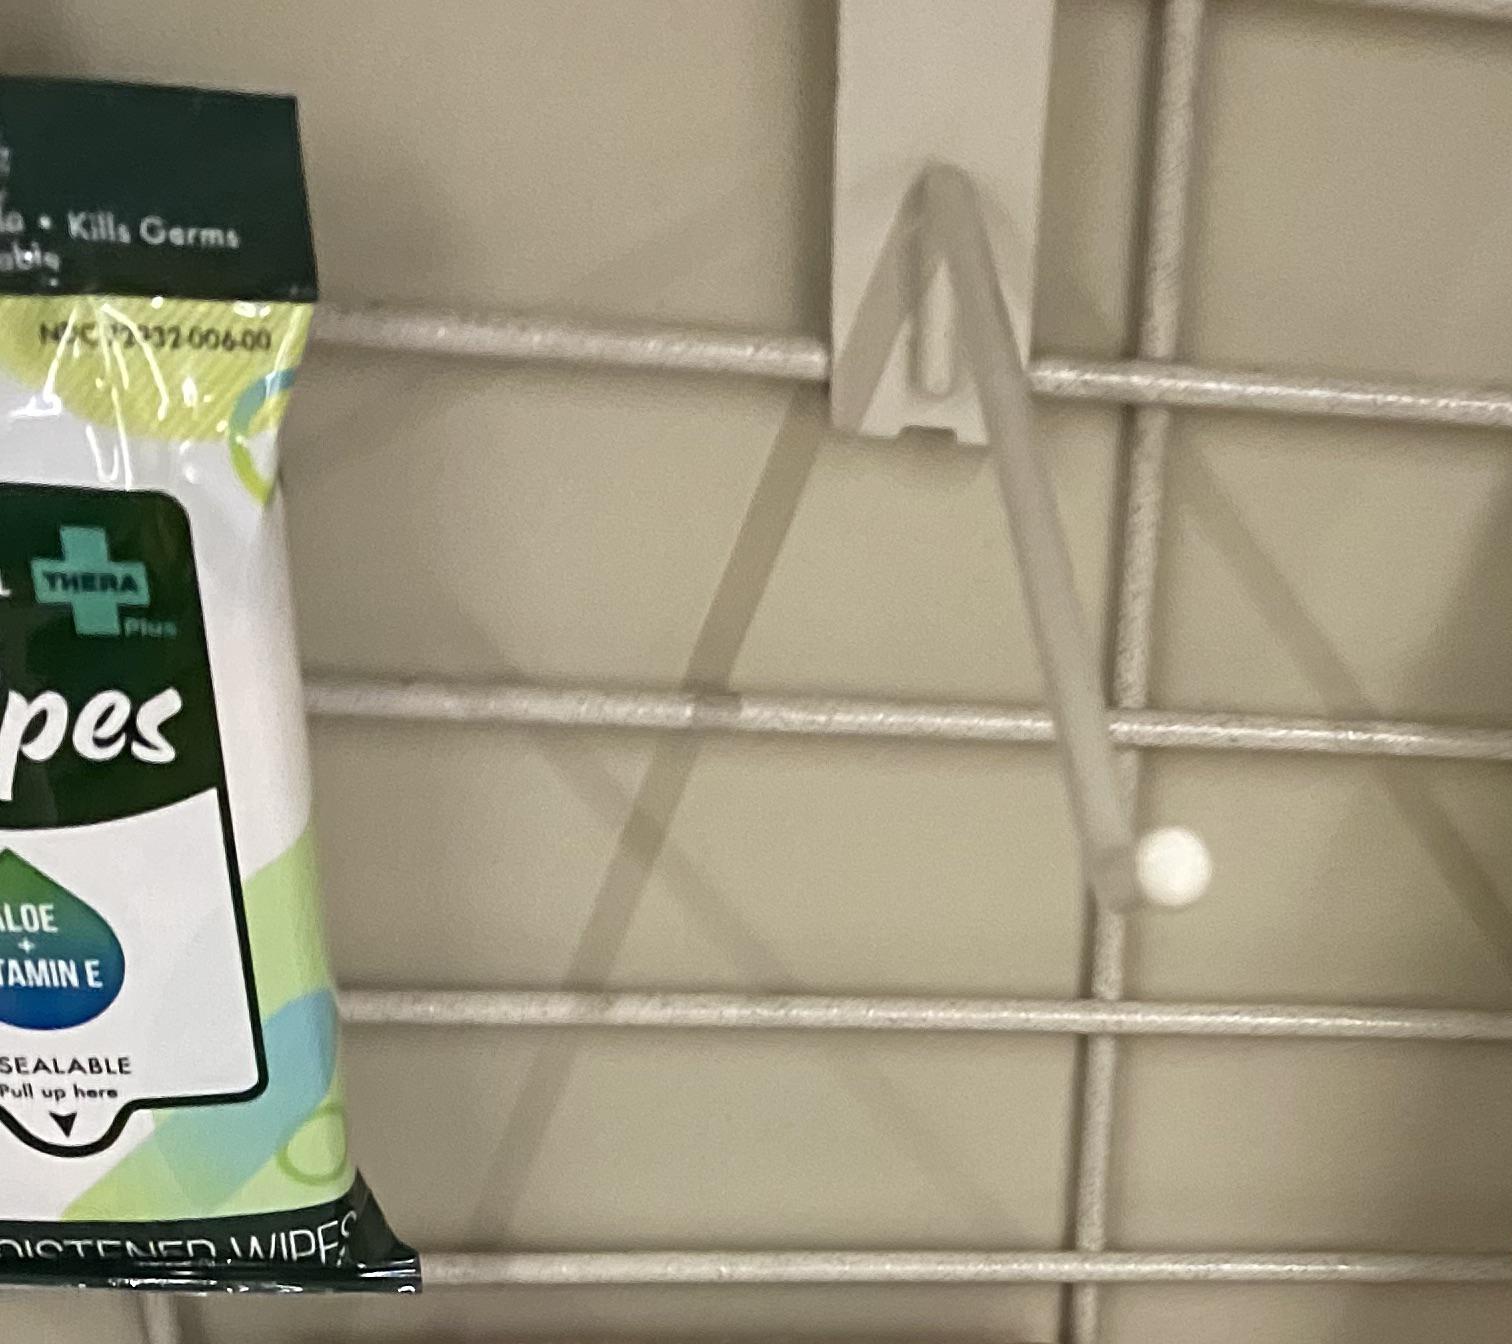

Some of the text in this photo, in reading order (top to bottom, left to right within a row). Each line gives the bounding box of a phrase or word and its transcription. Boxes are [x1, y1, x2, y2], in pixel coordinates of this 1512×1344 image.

[67, 209, 131, 245] Kills
[139, 214, 240, 250] Germs
[44, 569, 139, 593] THERA
[0, 687, 183, 800] pes
[0, 958, 104, 988] TAMIN E
[0, 1055, 132, 1076] SEALABLE
[41, 1087, 66, 1103] up
[74, 1083, 119, 1099] here
